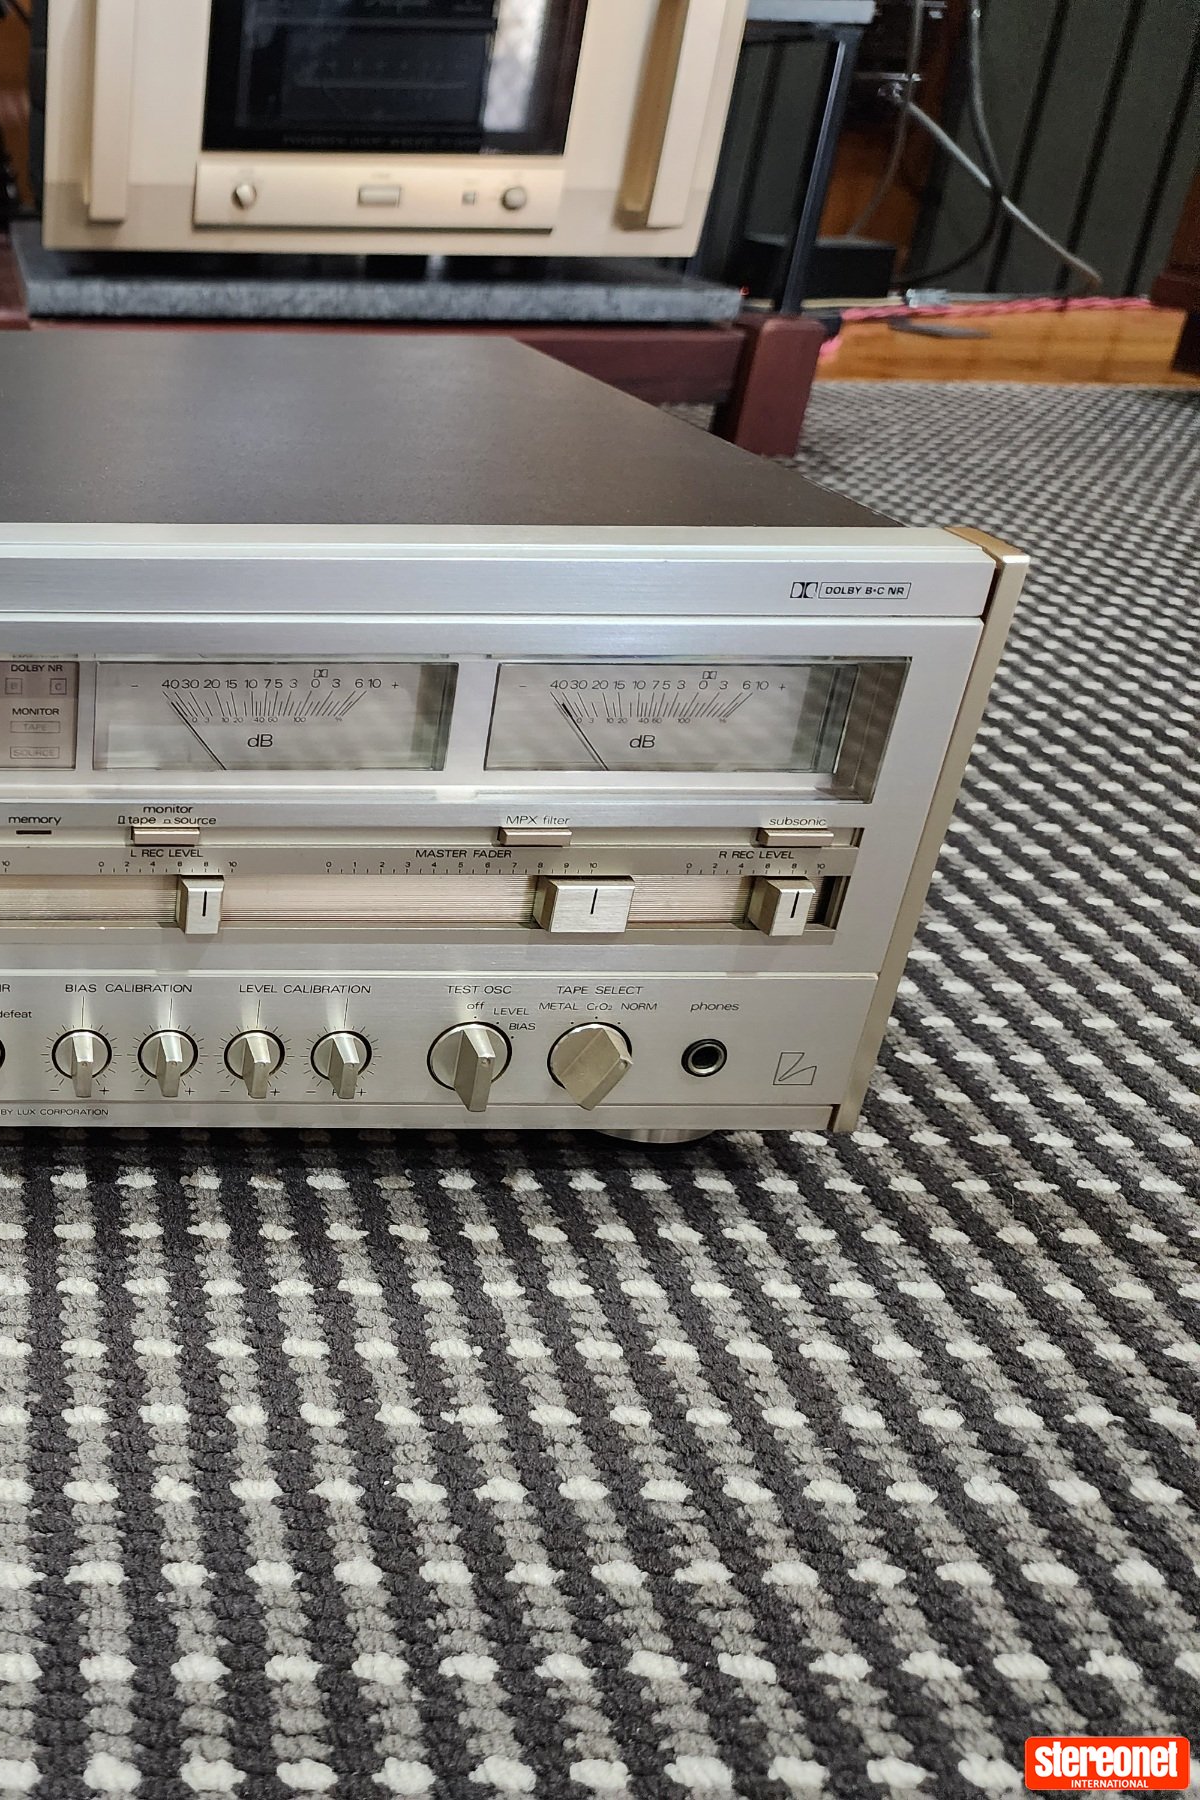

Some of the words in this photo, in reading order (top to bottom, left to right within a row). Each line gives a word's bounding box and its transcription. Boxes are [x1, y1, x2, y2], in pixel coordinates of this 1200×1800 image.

[825, 586, 862, 595] DOLBY
[888, 587, 904, 595] NR
[11, 664, 45, 672] DOLBY
[48, 664, 63, 672] NR
[162, 679, 179, 689] 40
[182, 679, 199, 689] 30
[204, 679, 220, 689] 20
[226, 679, 237, 688] 15
[246, 679, 257, 689] 10
[264, 678, 271, 688] 7
[275, 679, 283, 688] 5
[290, 679, 298, 688] 3
[311, 679, 320, 688] 0
[332, 679, 340, 688] 3
[355, 679, 364, 688] 6
[369, 679, 382, 688] 10
[550, 680, 568, 690] 40
[570, 680, 588, 690] 30
[592, 680, 608, 690] 20
[614, 680, 625, 690] 15
[633, 680, 646, 690] 10
[652, 680, 660, 690] 7
[662, 680, 671, 690] 5
[677, 680, 686, 690] 3
[699, 680, 708, 690] 0
[720, 680, 728, 690] 3
[743, 680, 751, 690] 6
[756, 680, 769, 690] 10
[247, 733, 274, 748] dB
[629, 734, 656, 749] dB
[143, 804, 193, 814] monitor
[8, 815, 62, 825] memory
[129, 815, 156, 825] tape
[174, 816, 217, 825] source
[506, 815, 538, 825] MPX
[543, 815, 570, 825] filter
[769, 816, 827, 826] subsonic
[131, 849, 137, 857] L
[142, 849, 164, 857] REC
[168, 849, 203, 857] LEVEL
[415, 849, 468, 858] MASTER
[473, 849, 512, 858] FADER
[719, 851, 728, 859] R
[732, 851, 754, 859] REC
[759, 851, 795, 859] LEVEL
[65, 984, 97, 993] BIAS
[105, 984, 192, 993] CALIBRATION
[239, 984, 278, 993] LEVEL
[283, 984, 372, 994] CALIBRATION
[447, 985, 480, 994] TEST
[484, 986, 512, 994] OSC
[557, 986, 588, 994] TAPE
[595, 986, 644, 994] SELECT
[467, 1002, 485, 1010] off
[621, 1003, 658, 1011] NORM
[690, 1002, 740, 1012] phones
[0, 1108, 13, 1116] BY
[17, 1108, 36, 1116] LUX
[40, 1108, 109, 1116] CORPORATION
